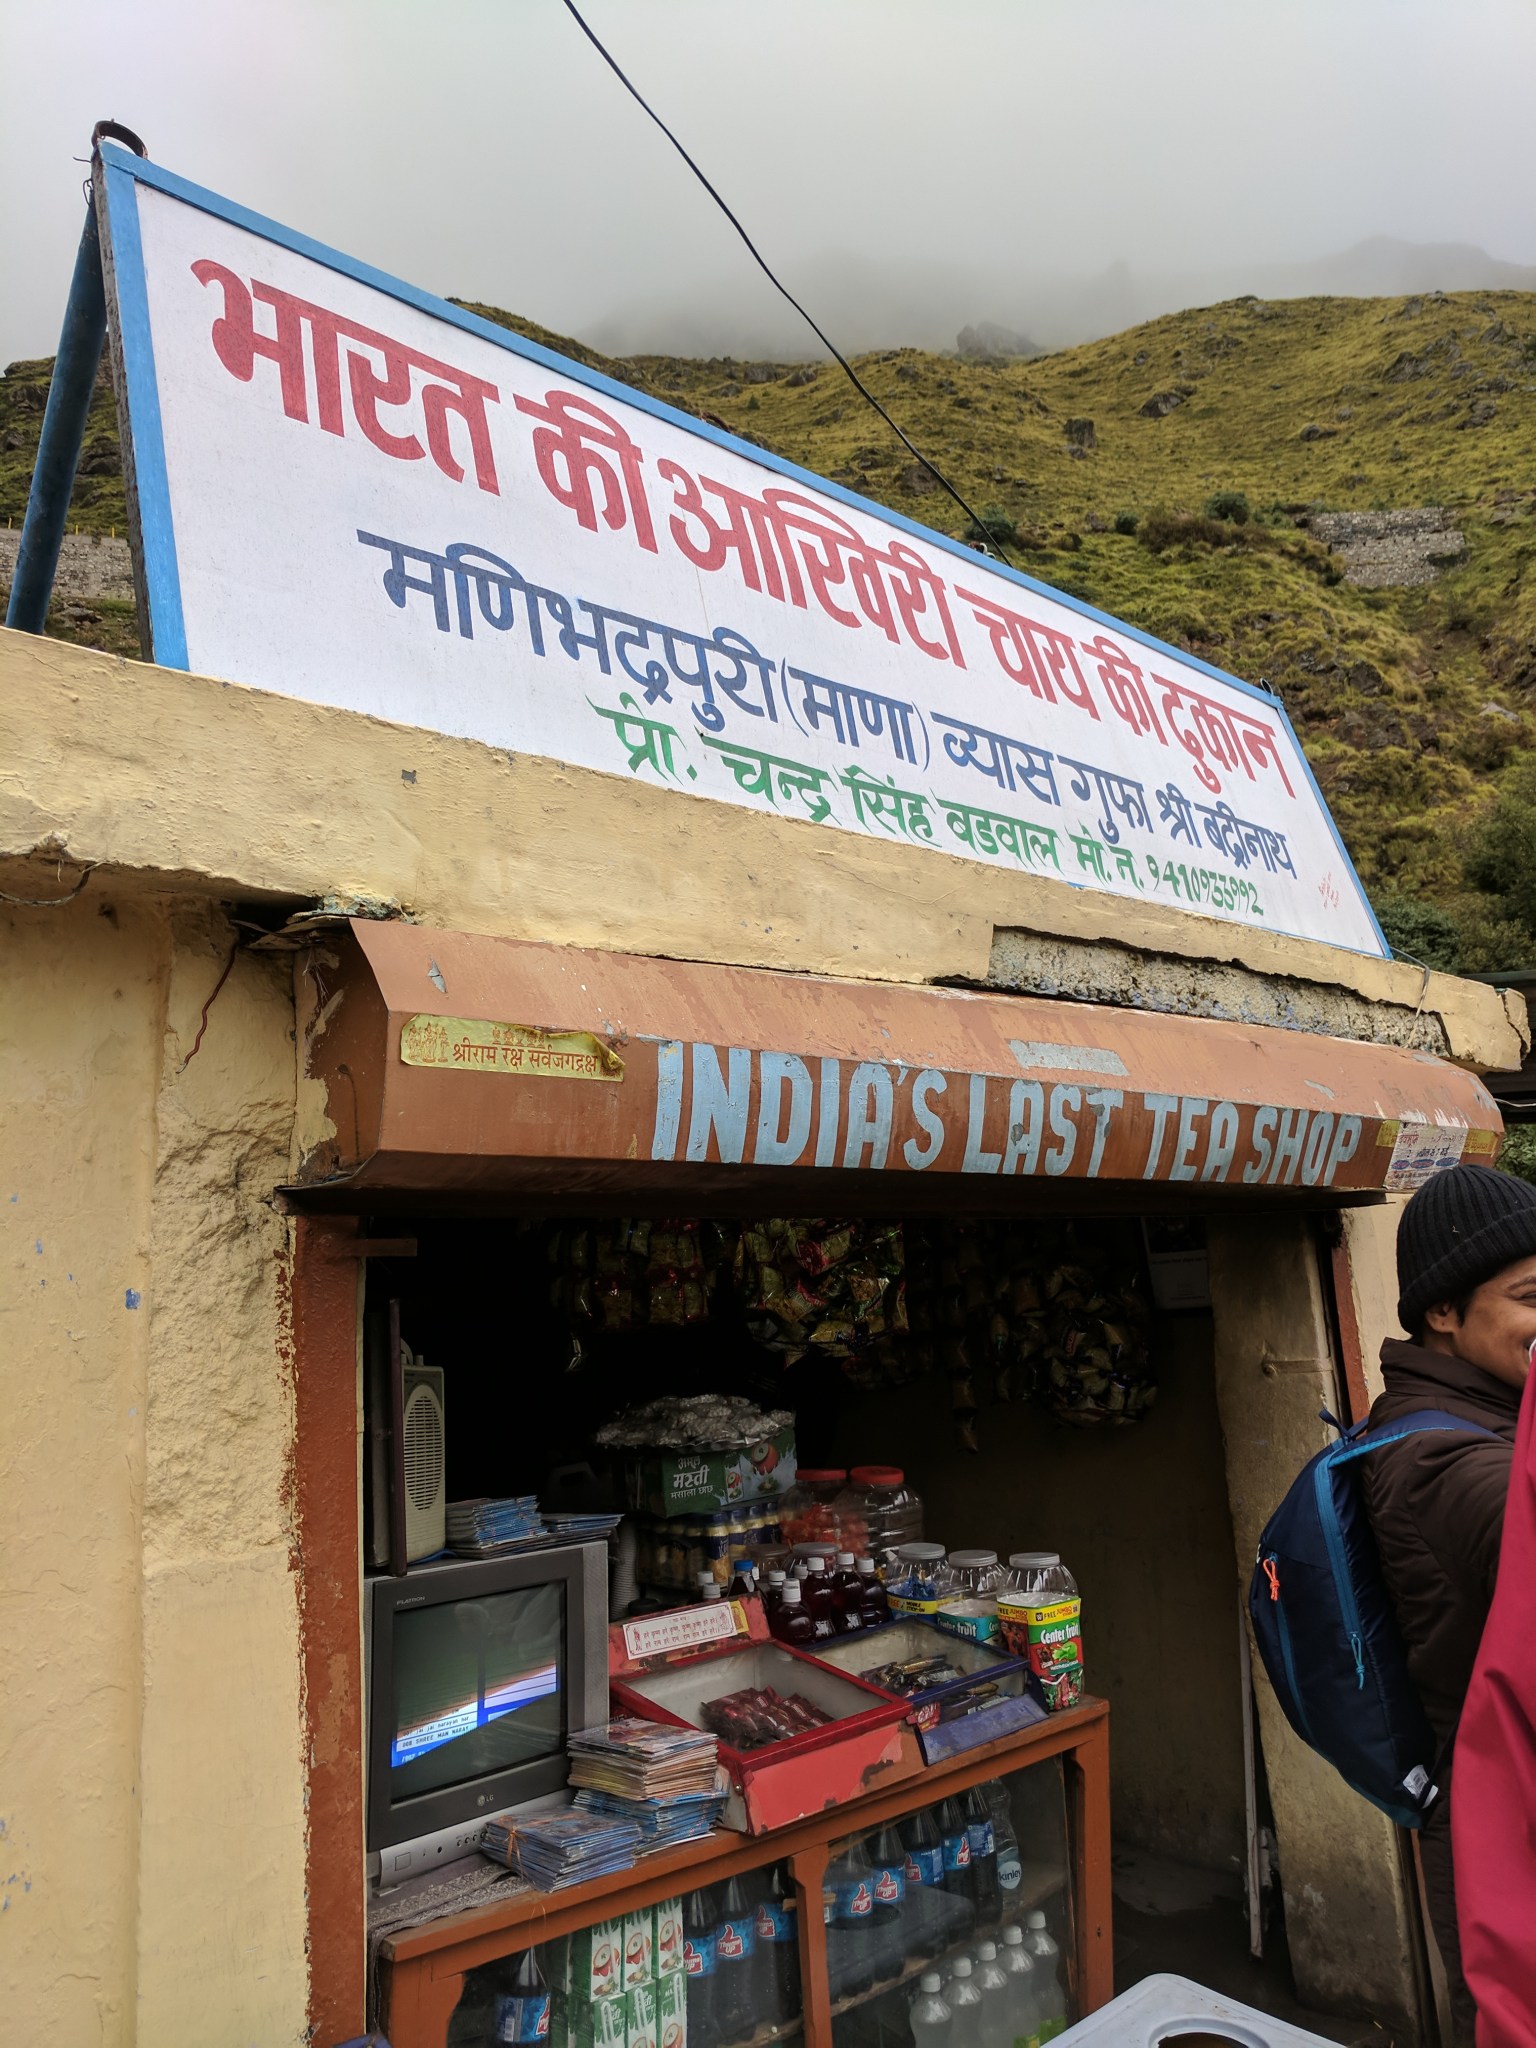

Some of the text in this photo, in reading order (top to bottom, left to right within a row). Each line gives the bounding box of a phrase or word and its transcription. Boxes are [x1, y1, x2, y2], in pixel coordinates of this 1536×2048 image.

[190, 258, 1297, 795] भारत की आखिरी चाय की दुकान
[694, 725, 842, 826] चन्द्र
[832, 763, 942, 848] सिंह
[930, 710, 1061, 807] व्यास
[1056, 754, 1154, 845] गुफा
[1155, 782, 1203, 849] श्री
[1193, 800, 1298, 881] बद्रीनाथ
[452, 1036, 498, 1065] श्रीराम
[651, 1040, 1363, 1187] INDIA'S LAST TEA SHOP
[672, 1464, 710, 1489] मस्ती
[670, 1488, 696, 1500] मसाला
[1043, 1611, 1056, 1619] FREE
[1040, 1628, 1065, 1645] Center
[416, 1734, 434, 1743] SHREE
[437, 1730, 449, 1739] MAN
